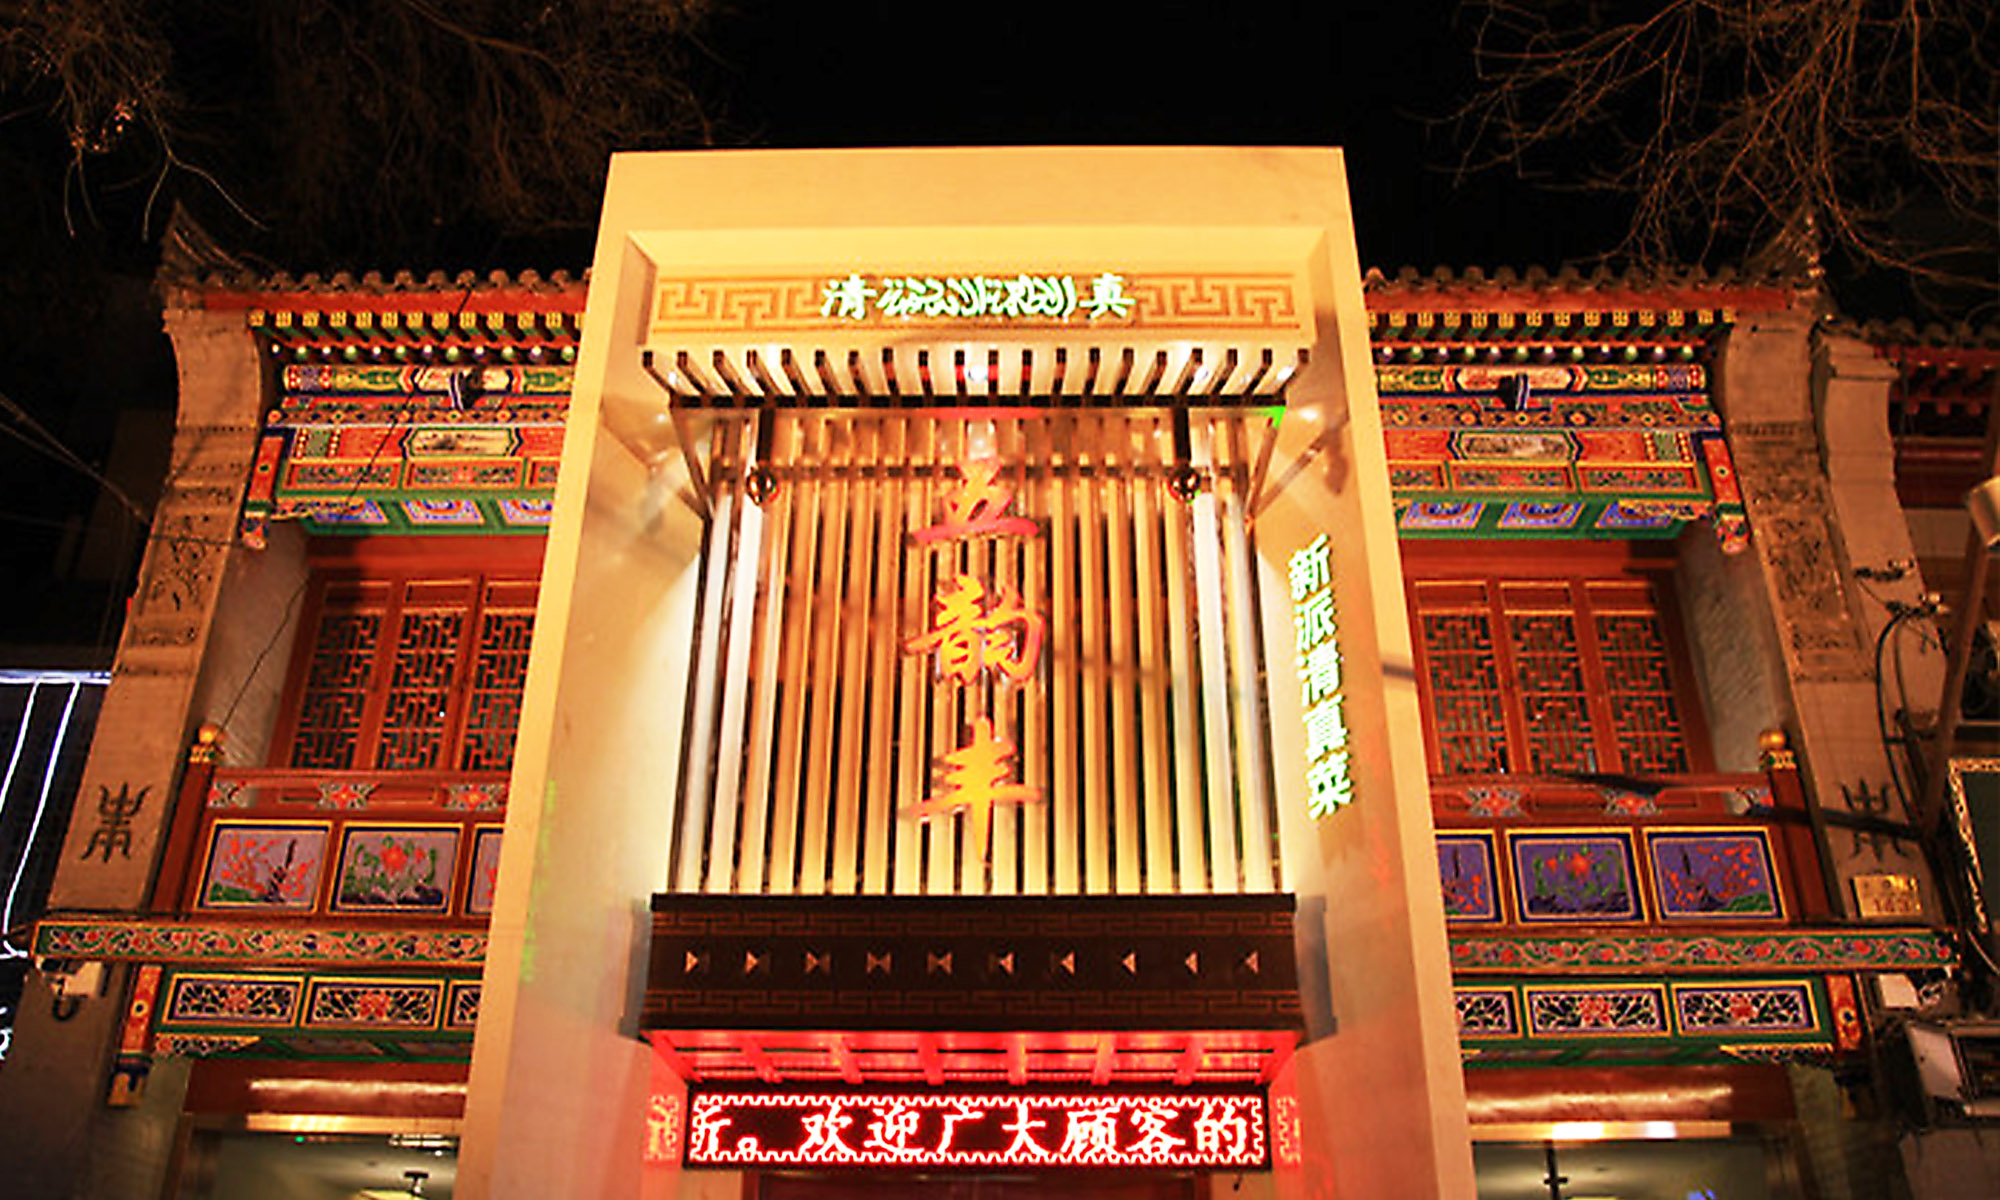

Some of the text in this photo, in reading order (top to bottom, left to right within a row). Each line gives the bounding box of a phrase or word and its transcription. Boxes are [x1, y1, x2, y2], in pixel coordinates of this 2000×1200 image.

[820, 272, 1137, 320] 清 真
[1288, 533, 1355, 820] 新派清真菜
